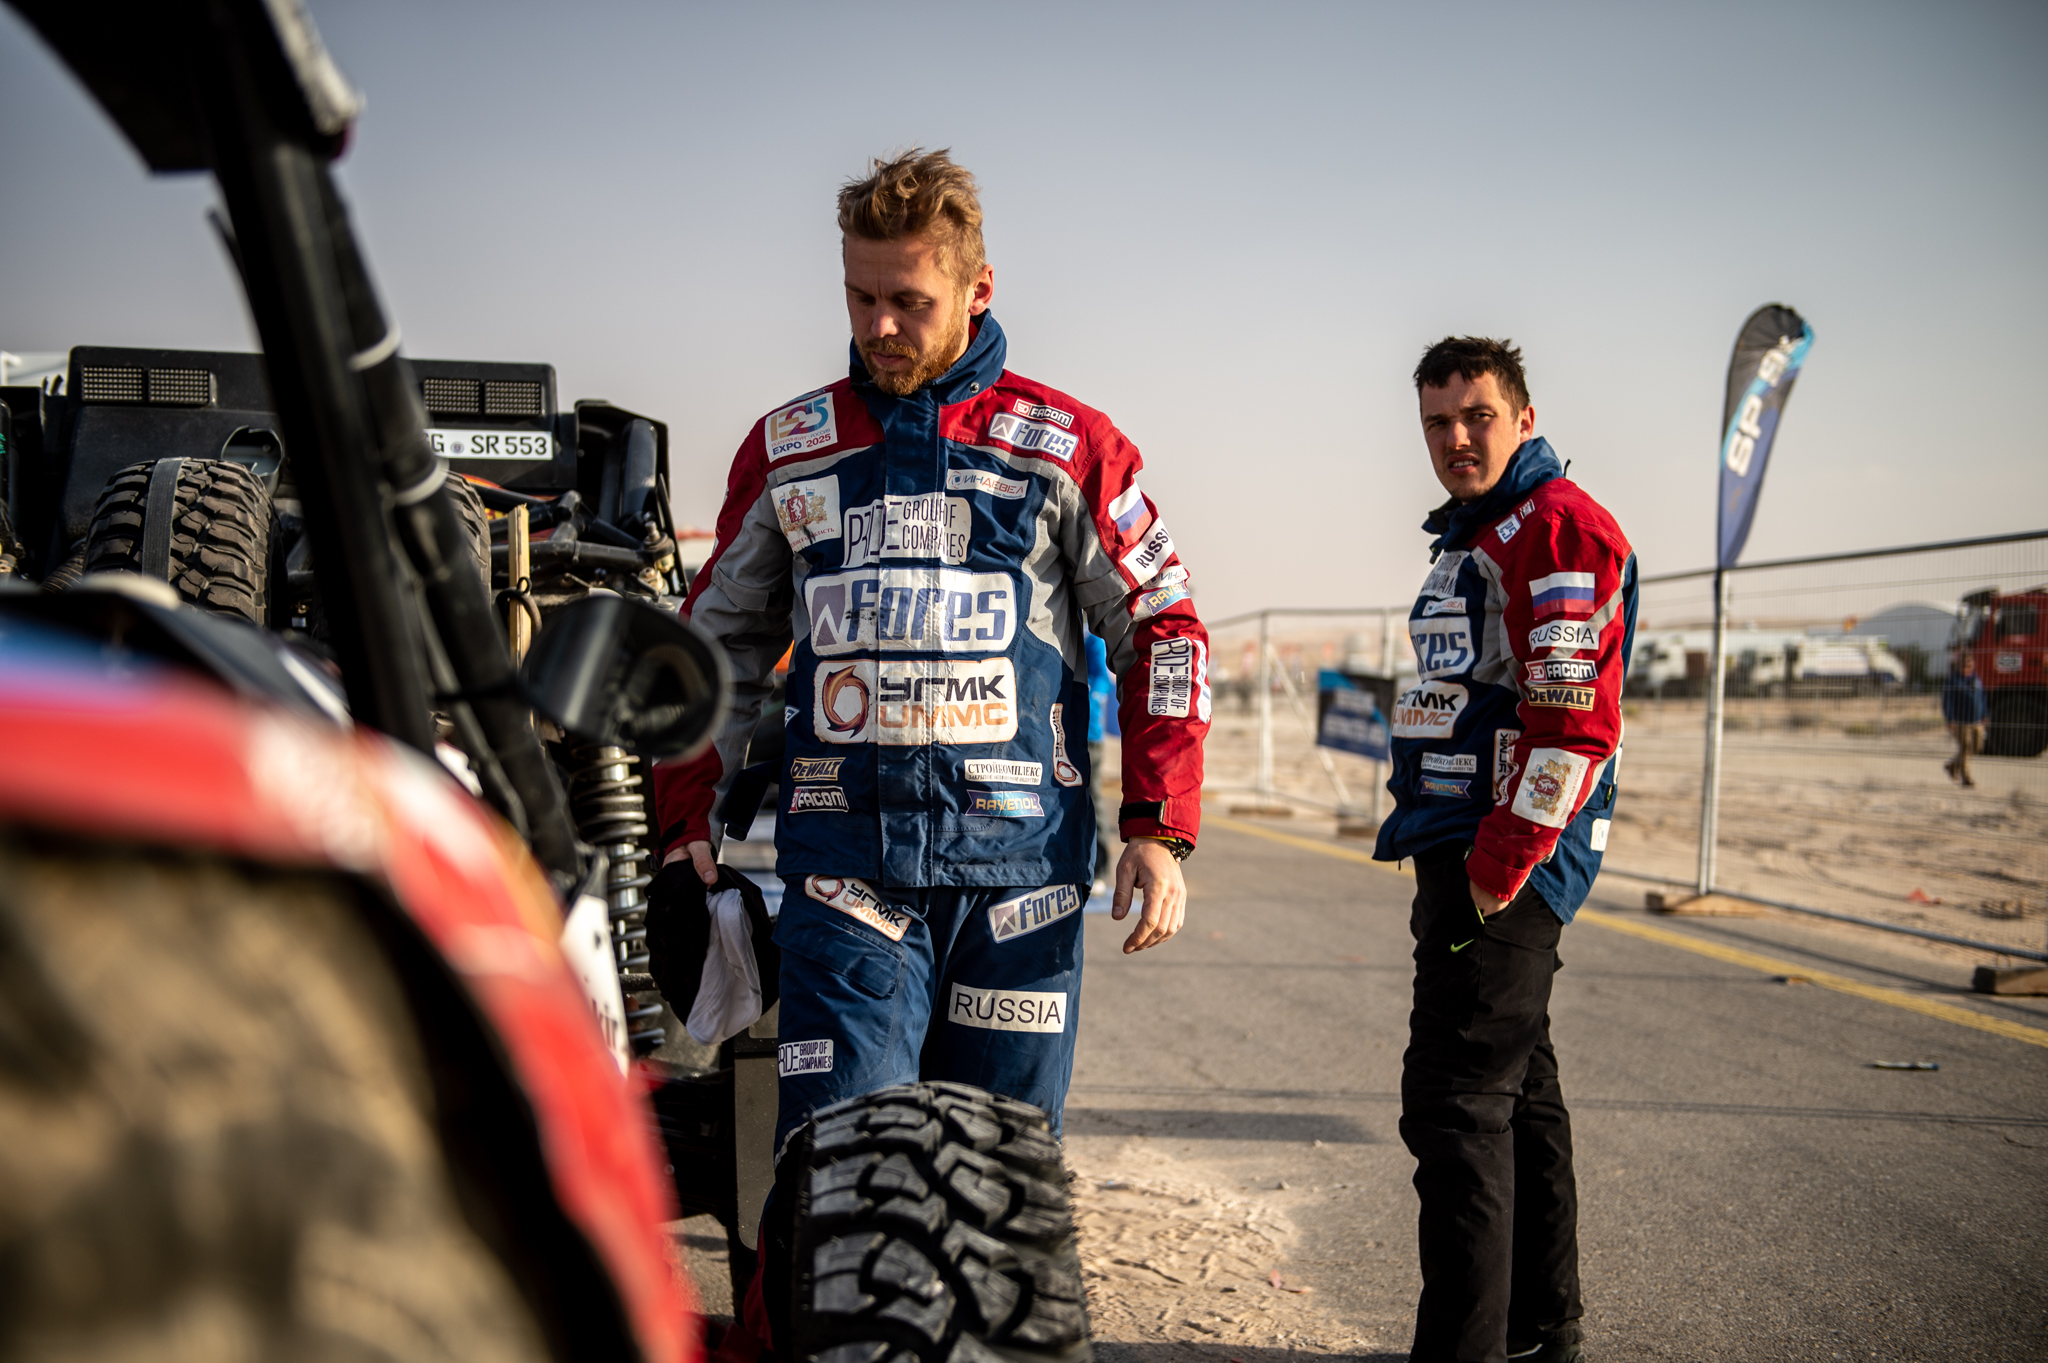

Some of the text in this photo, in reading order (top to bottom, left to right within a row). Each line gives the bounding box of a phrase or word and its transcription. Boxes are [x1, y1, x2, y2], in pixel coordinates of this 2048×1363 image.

[1030, 407, 1070, 426] FACOM
[772, 433, 832, 456] EXPO 2025
[1530, 625, 1595, 645] RUSSIA
[1546, 663, 1594, 678] FACOM
[875, 674, 1007, 702] УГМК
[875, 702, 1009, 729] UMMC
[797, 791, 846, 808] FACOM
[975, 797, 1038, 811] RAVENOL
[842, 893, 899, 935] UMMC
[847, 882, 905, 928] УГМК
[954, 991, 1061, 1024] RUSSIA
[778, 1043, 800, 1073] RIDE
